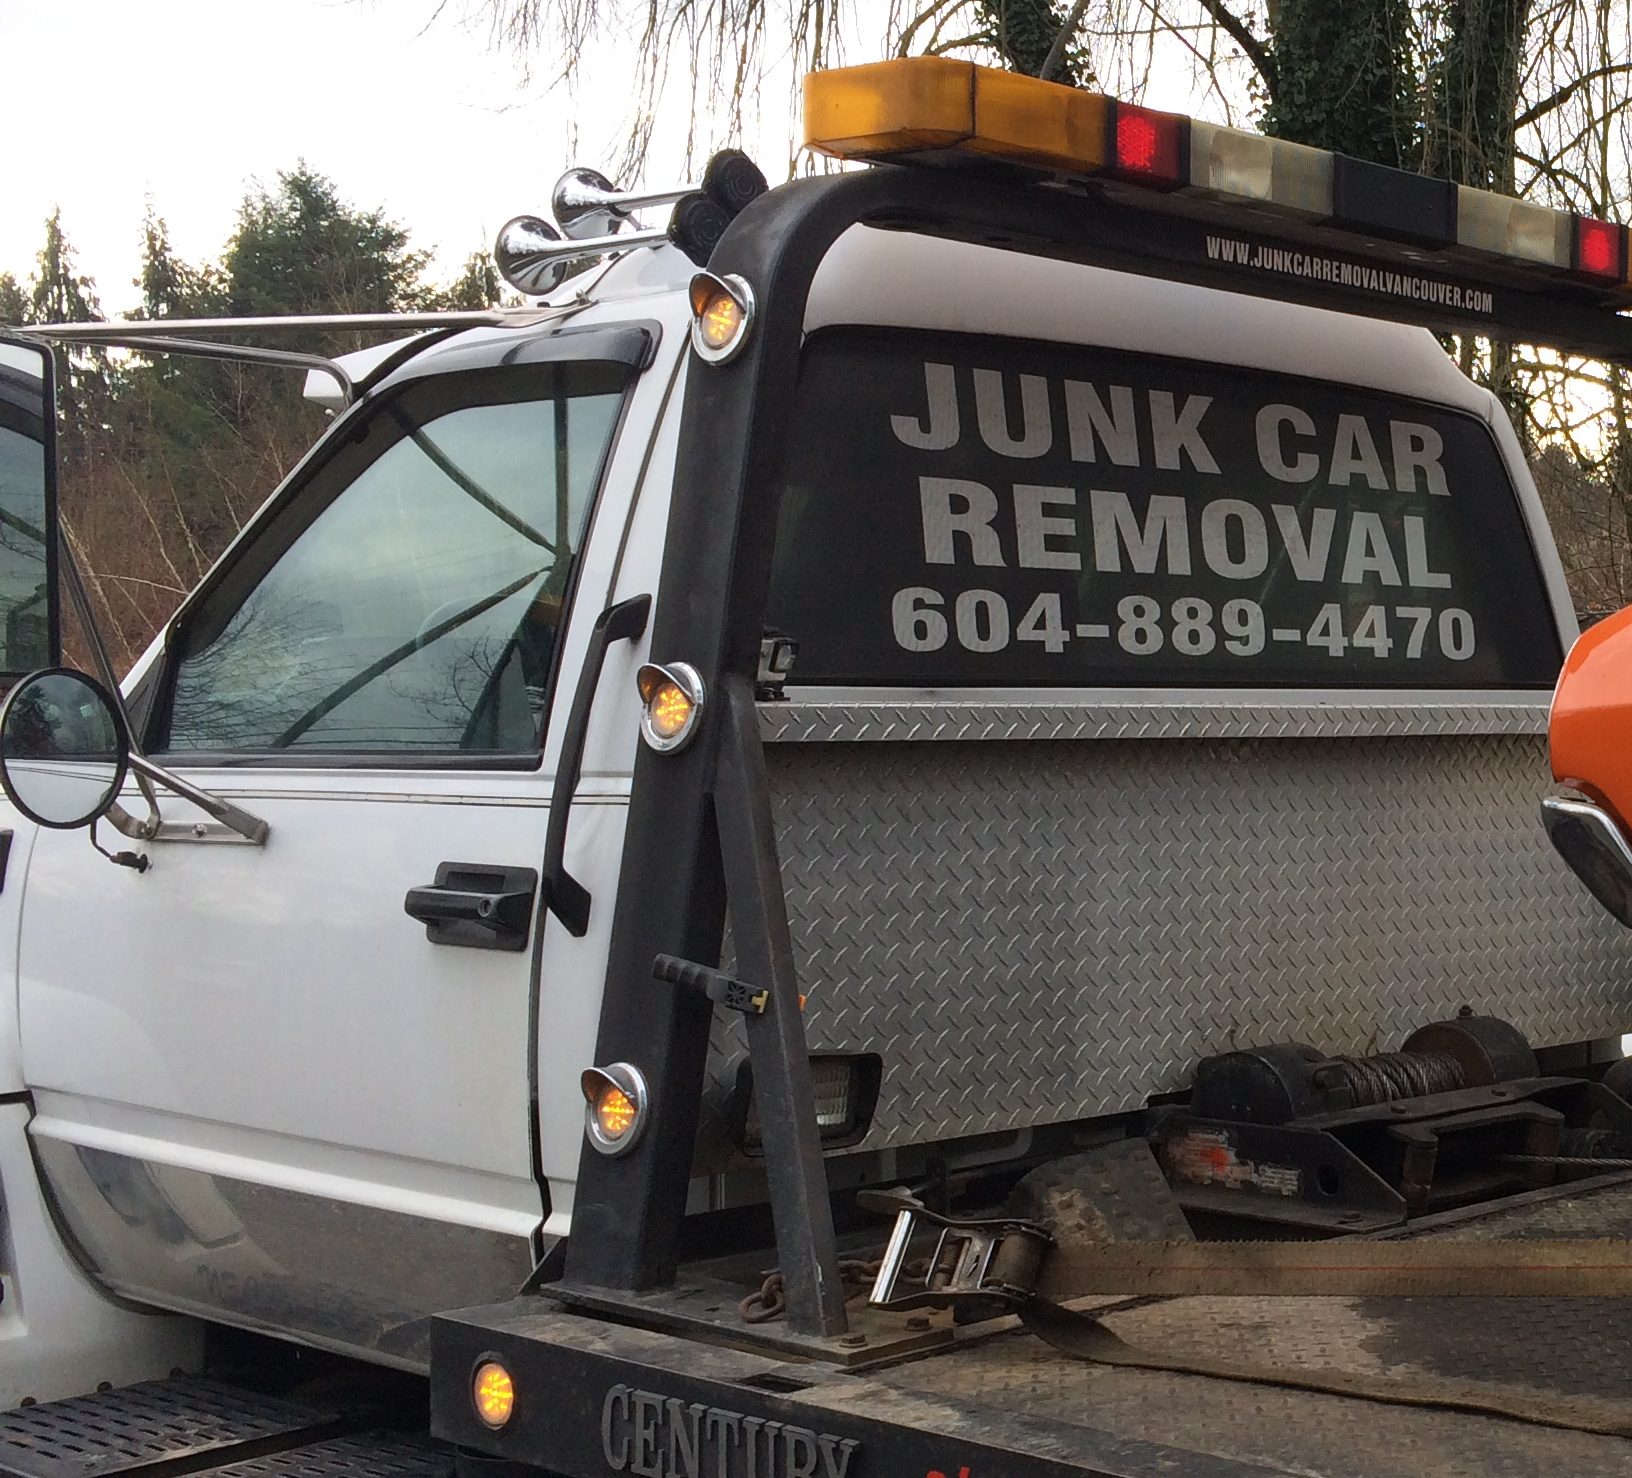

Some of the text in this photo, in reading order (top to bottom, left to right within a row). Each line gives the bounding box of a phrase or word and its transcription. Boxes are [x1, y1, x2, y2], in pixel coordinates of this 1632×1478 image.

[1206, 235, 1493, 314] WWW.JUNKCARREMOVALVANCOUVER.COM
[890, 362, 1452, 497] JUNK CAR
[919, 476, 1453, 590] REMOVAL
[891, 585, 1476, 662] 604-889-4470
